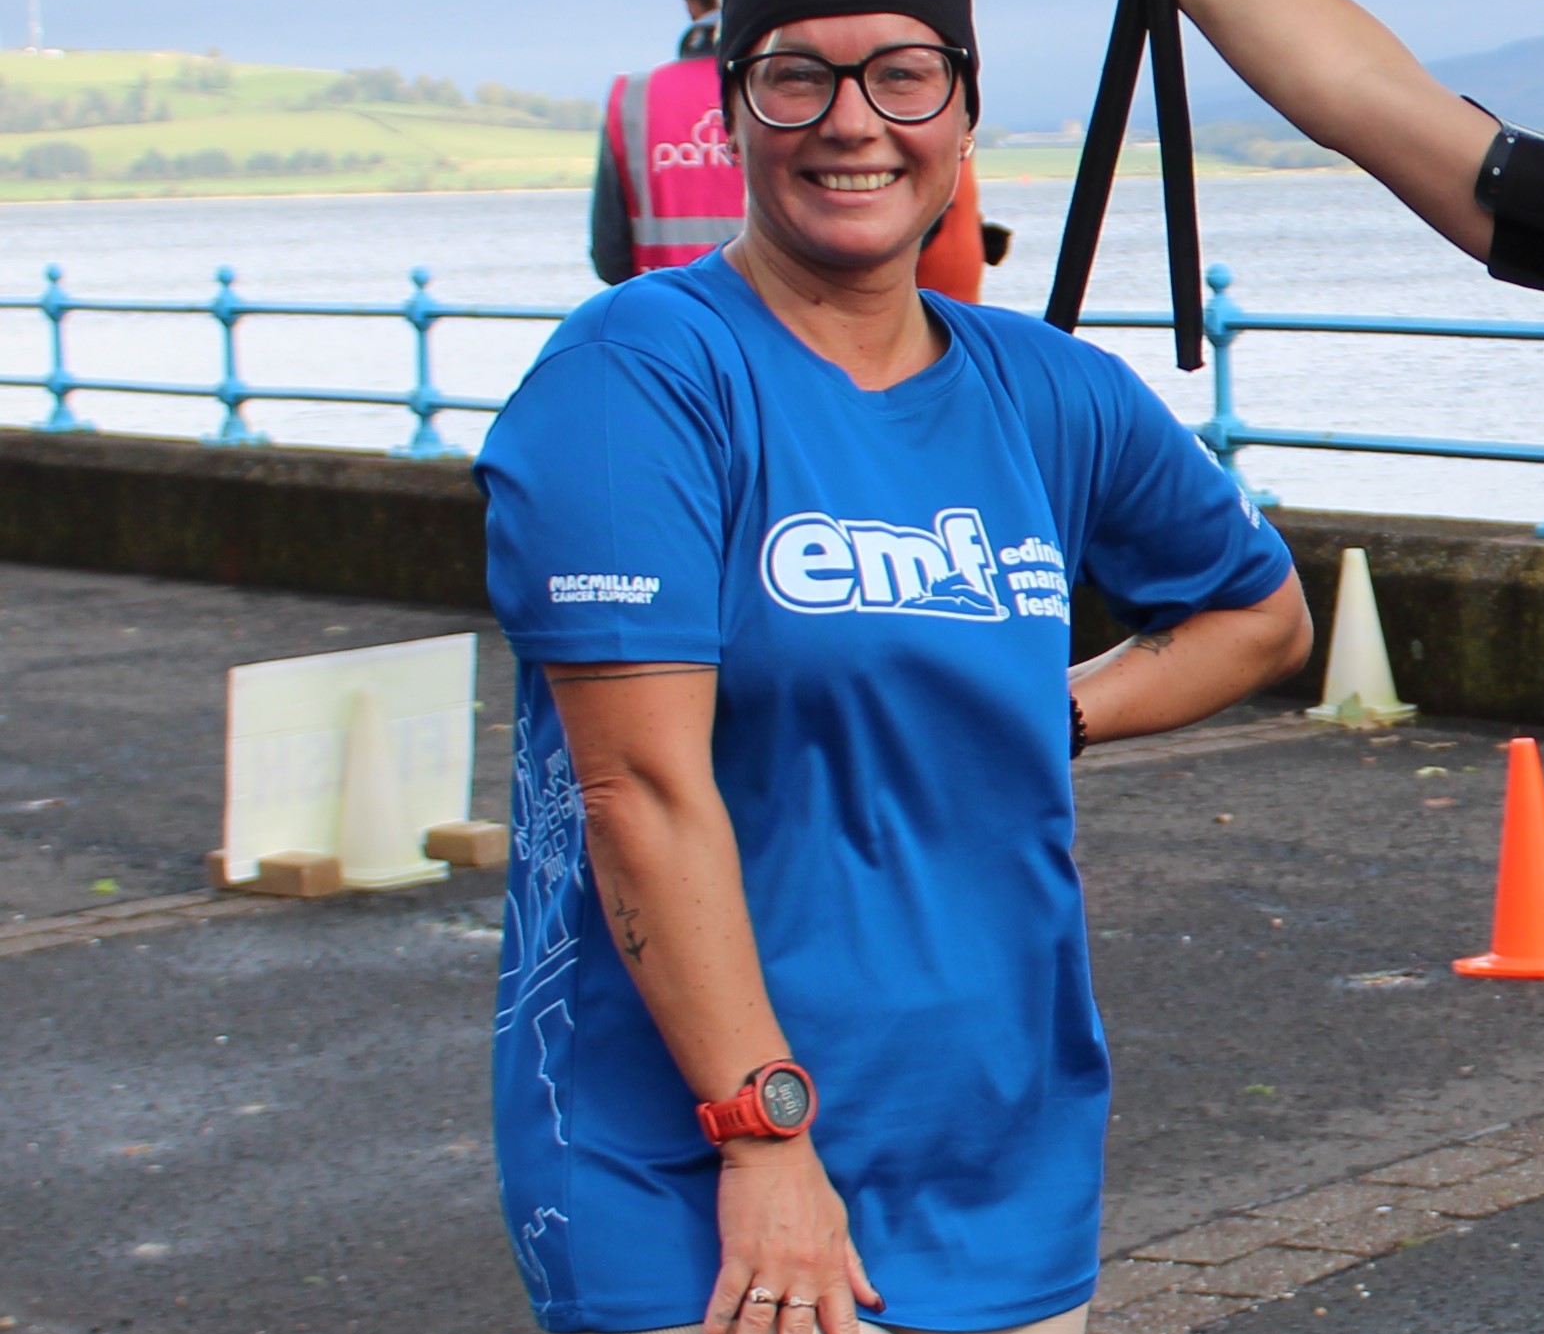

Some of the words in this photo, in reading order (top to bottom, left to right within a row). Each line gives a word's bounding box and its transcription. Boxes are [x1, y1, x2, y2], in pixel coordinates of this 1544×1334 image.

[653, 126, 735, 171] park
[762, 508, 998, 619] emf
[549, 574, 661, 593] MACMILLAN
[551, 591, 595, 603] CANCER
[597, 591, 653, 604] SUPPORT
